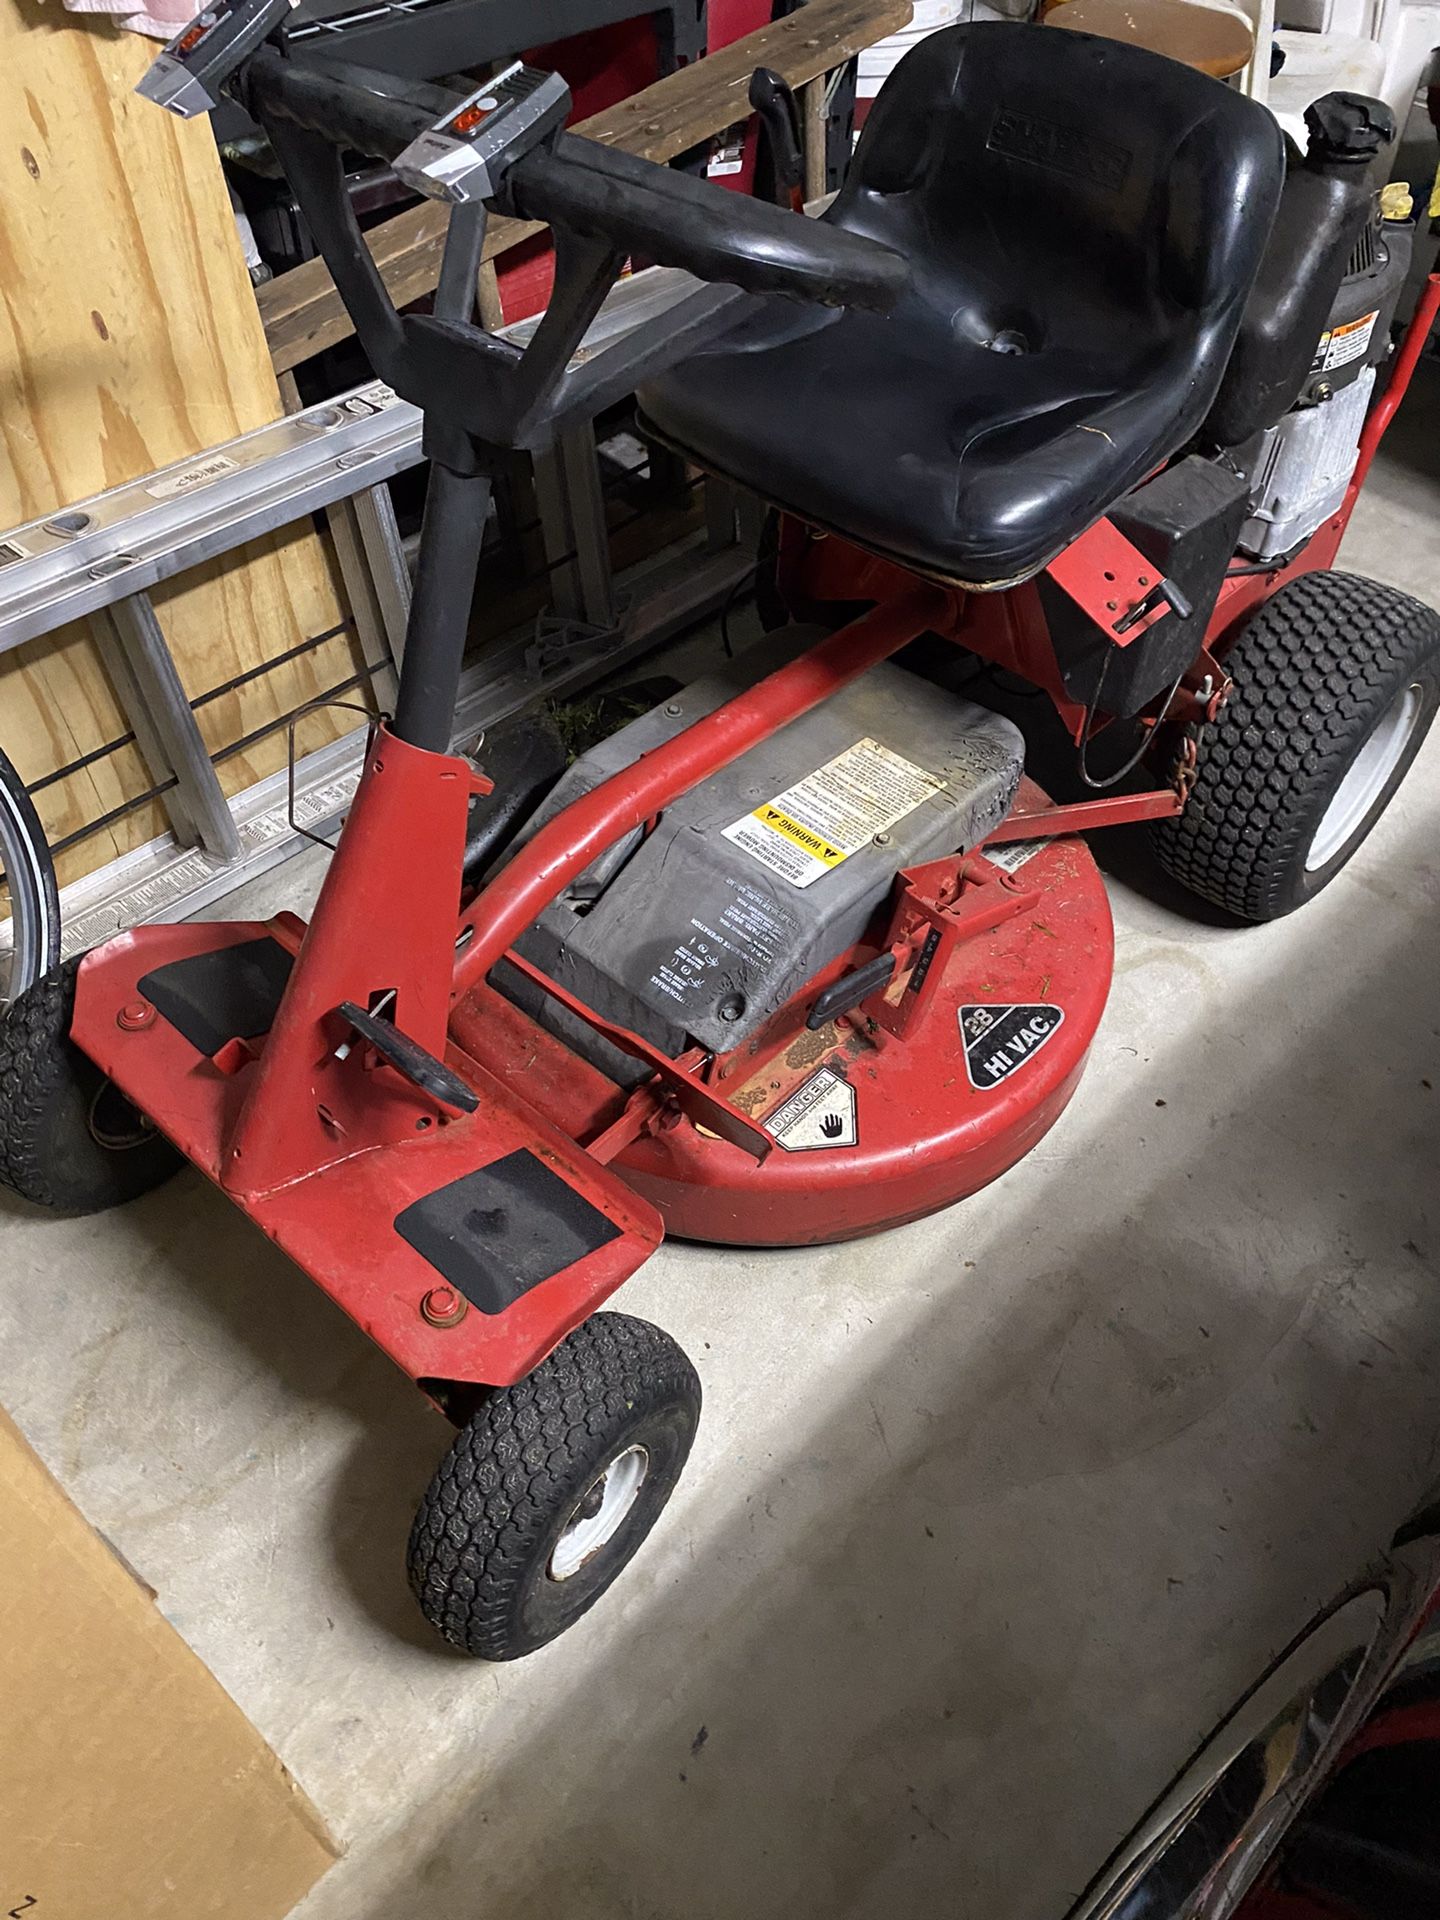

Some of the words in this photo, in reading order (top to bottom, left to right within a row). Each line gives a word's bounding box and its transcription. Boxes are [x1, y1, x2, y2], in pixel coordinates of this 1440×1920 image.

[732, 833, 754, 849] ENGINE
[737, 829, 760, 846] MOWER
[777, 818, 822, 850] WARNING
[750, 846, 778, 866] STARTING
[757, 843, 796, 871] DISMOUNTING
[776, 863, 799, 880] BEFORE
[689, 916, 724, 943] OPERATION
[964, 1008, 994, 1036] 28
[984, 1050, 1014, 1079] HI
[767, 1074, 832, 1132] DANGER
[781, 1125, 795, 1138] KEEP
[792, 1111, 809, 1127] HANDS
[814, 1094, 827, 1106] FEET
